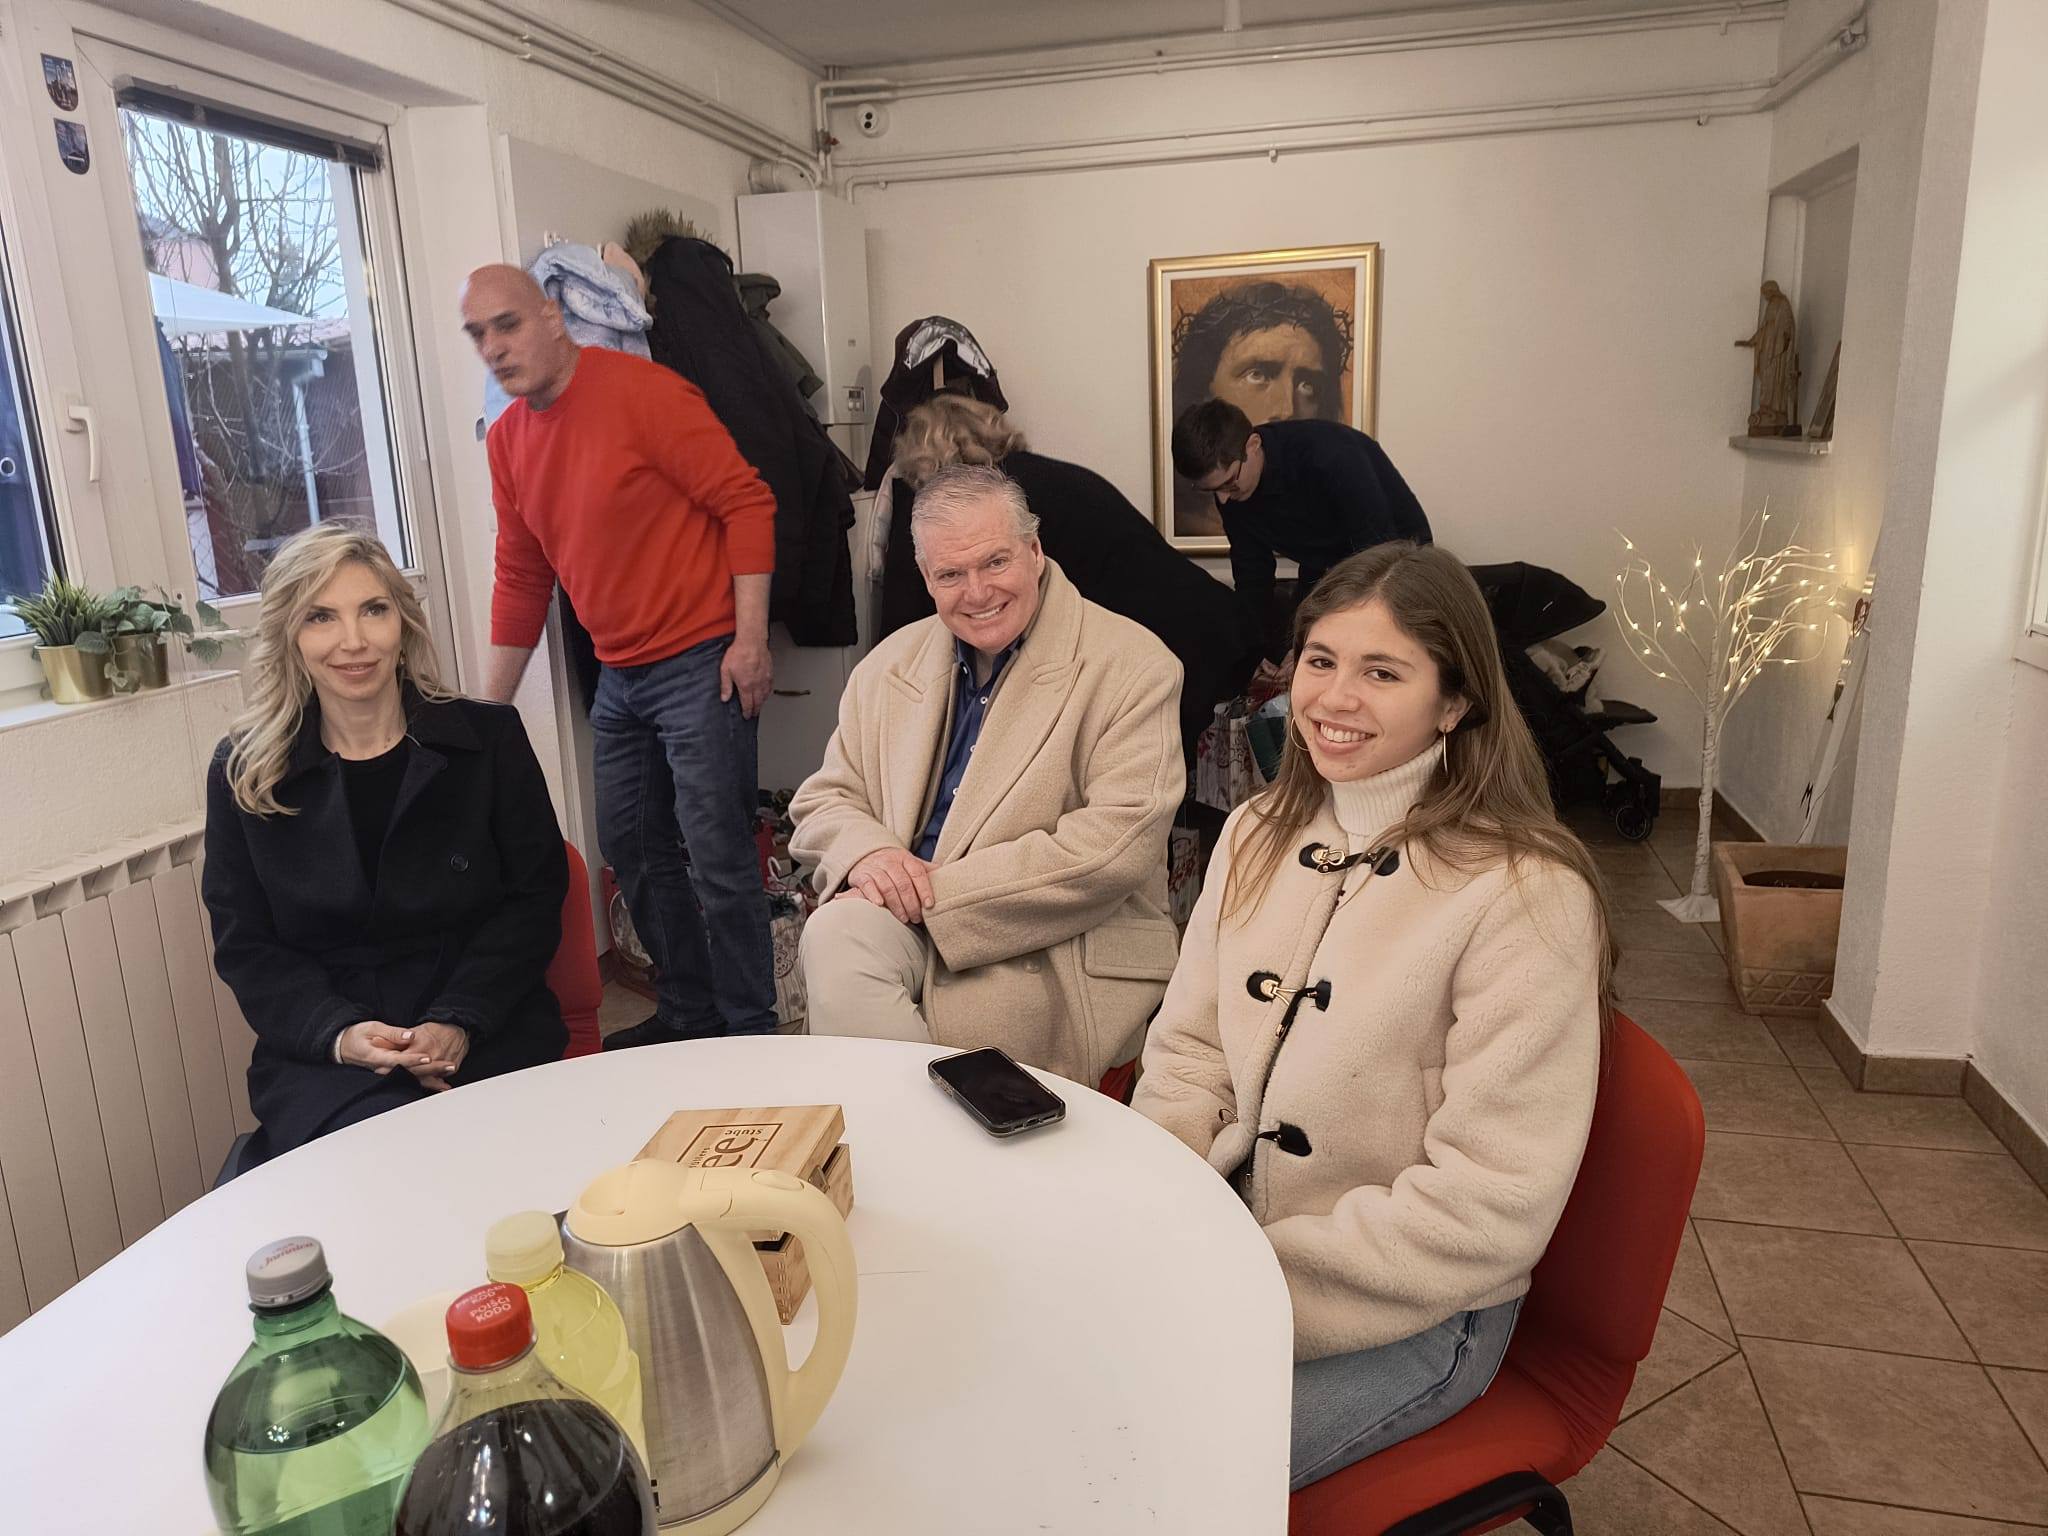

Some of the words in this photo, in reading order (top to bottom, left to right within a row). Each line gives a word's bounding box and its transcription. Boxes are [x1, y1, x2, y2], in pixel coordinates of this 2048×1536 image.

[725, 1128, 763, 1137] stube
[702, 1137, 755, 1168] ee
[475, 1303, 512, 1323] KODO
